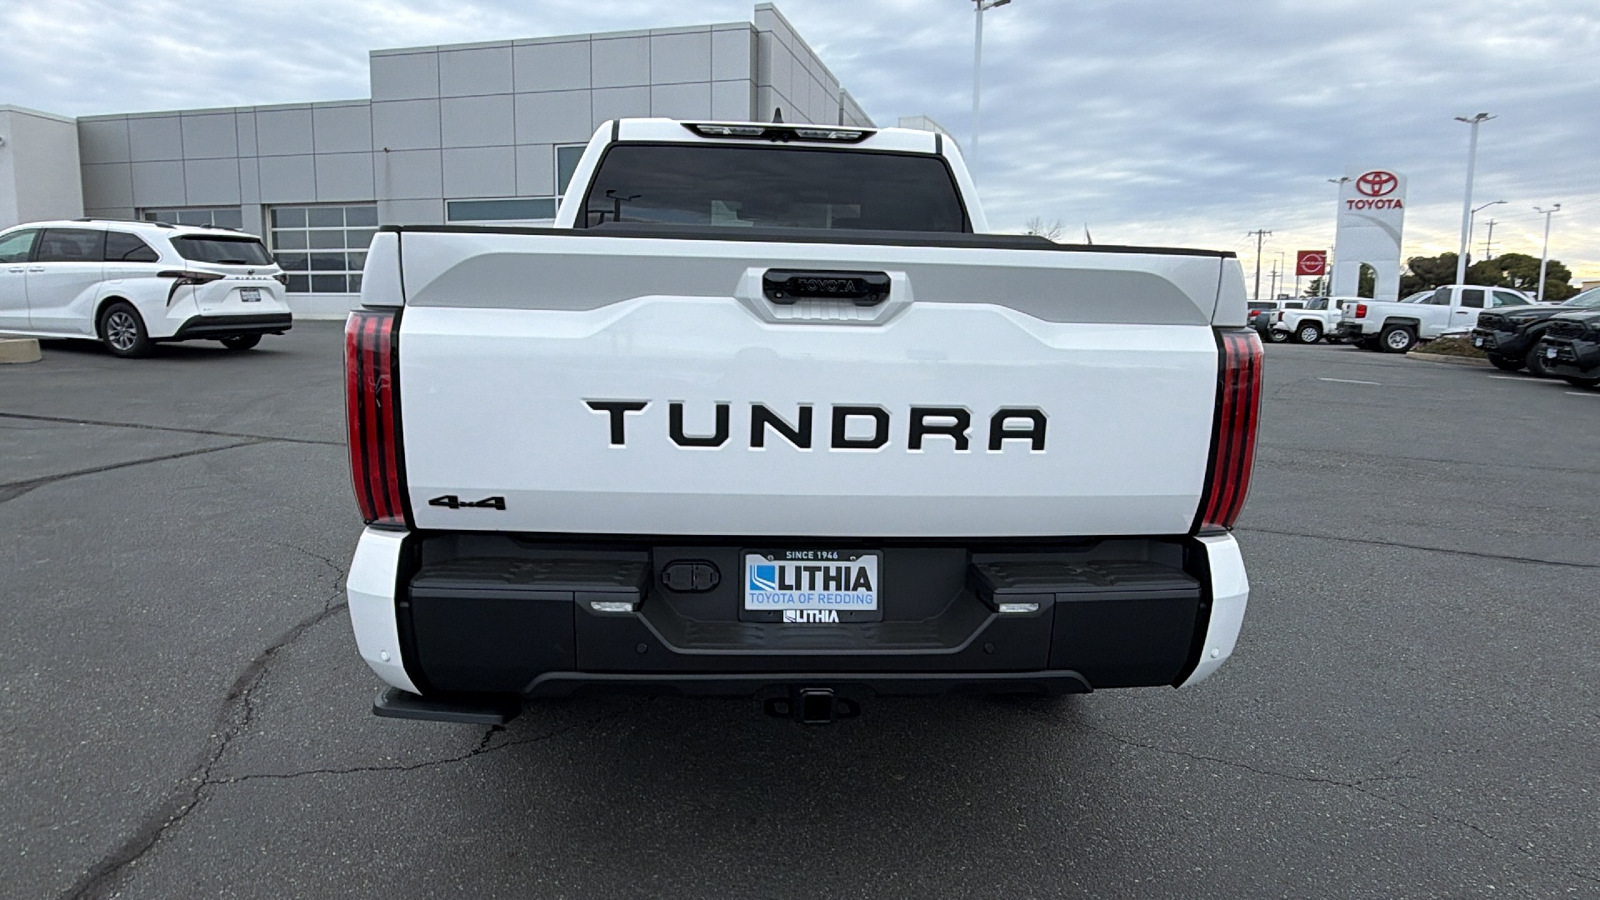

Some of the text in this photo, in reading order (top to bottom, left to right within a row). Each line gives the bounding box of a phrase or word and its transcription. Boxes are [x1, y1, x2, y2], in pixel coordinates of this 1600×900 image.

[1346, 198, 1403, 210] TOYOTA
[798, 278, 857, 293] TOYOTA
[583, 399, 1049, 453] TUNDRA
[786, 551, 838, 560] SINCE 1946
[778, 565, 873, 592] LITHIA
[749, 593, 873, 605] TOYOTA OF REDDING
[796, 610, 840, 623] LITHIA
